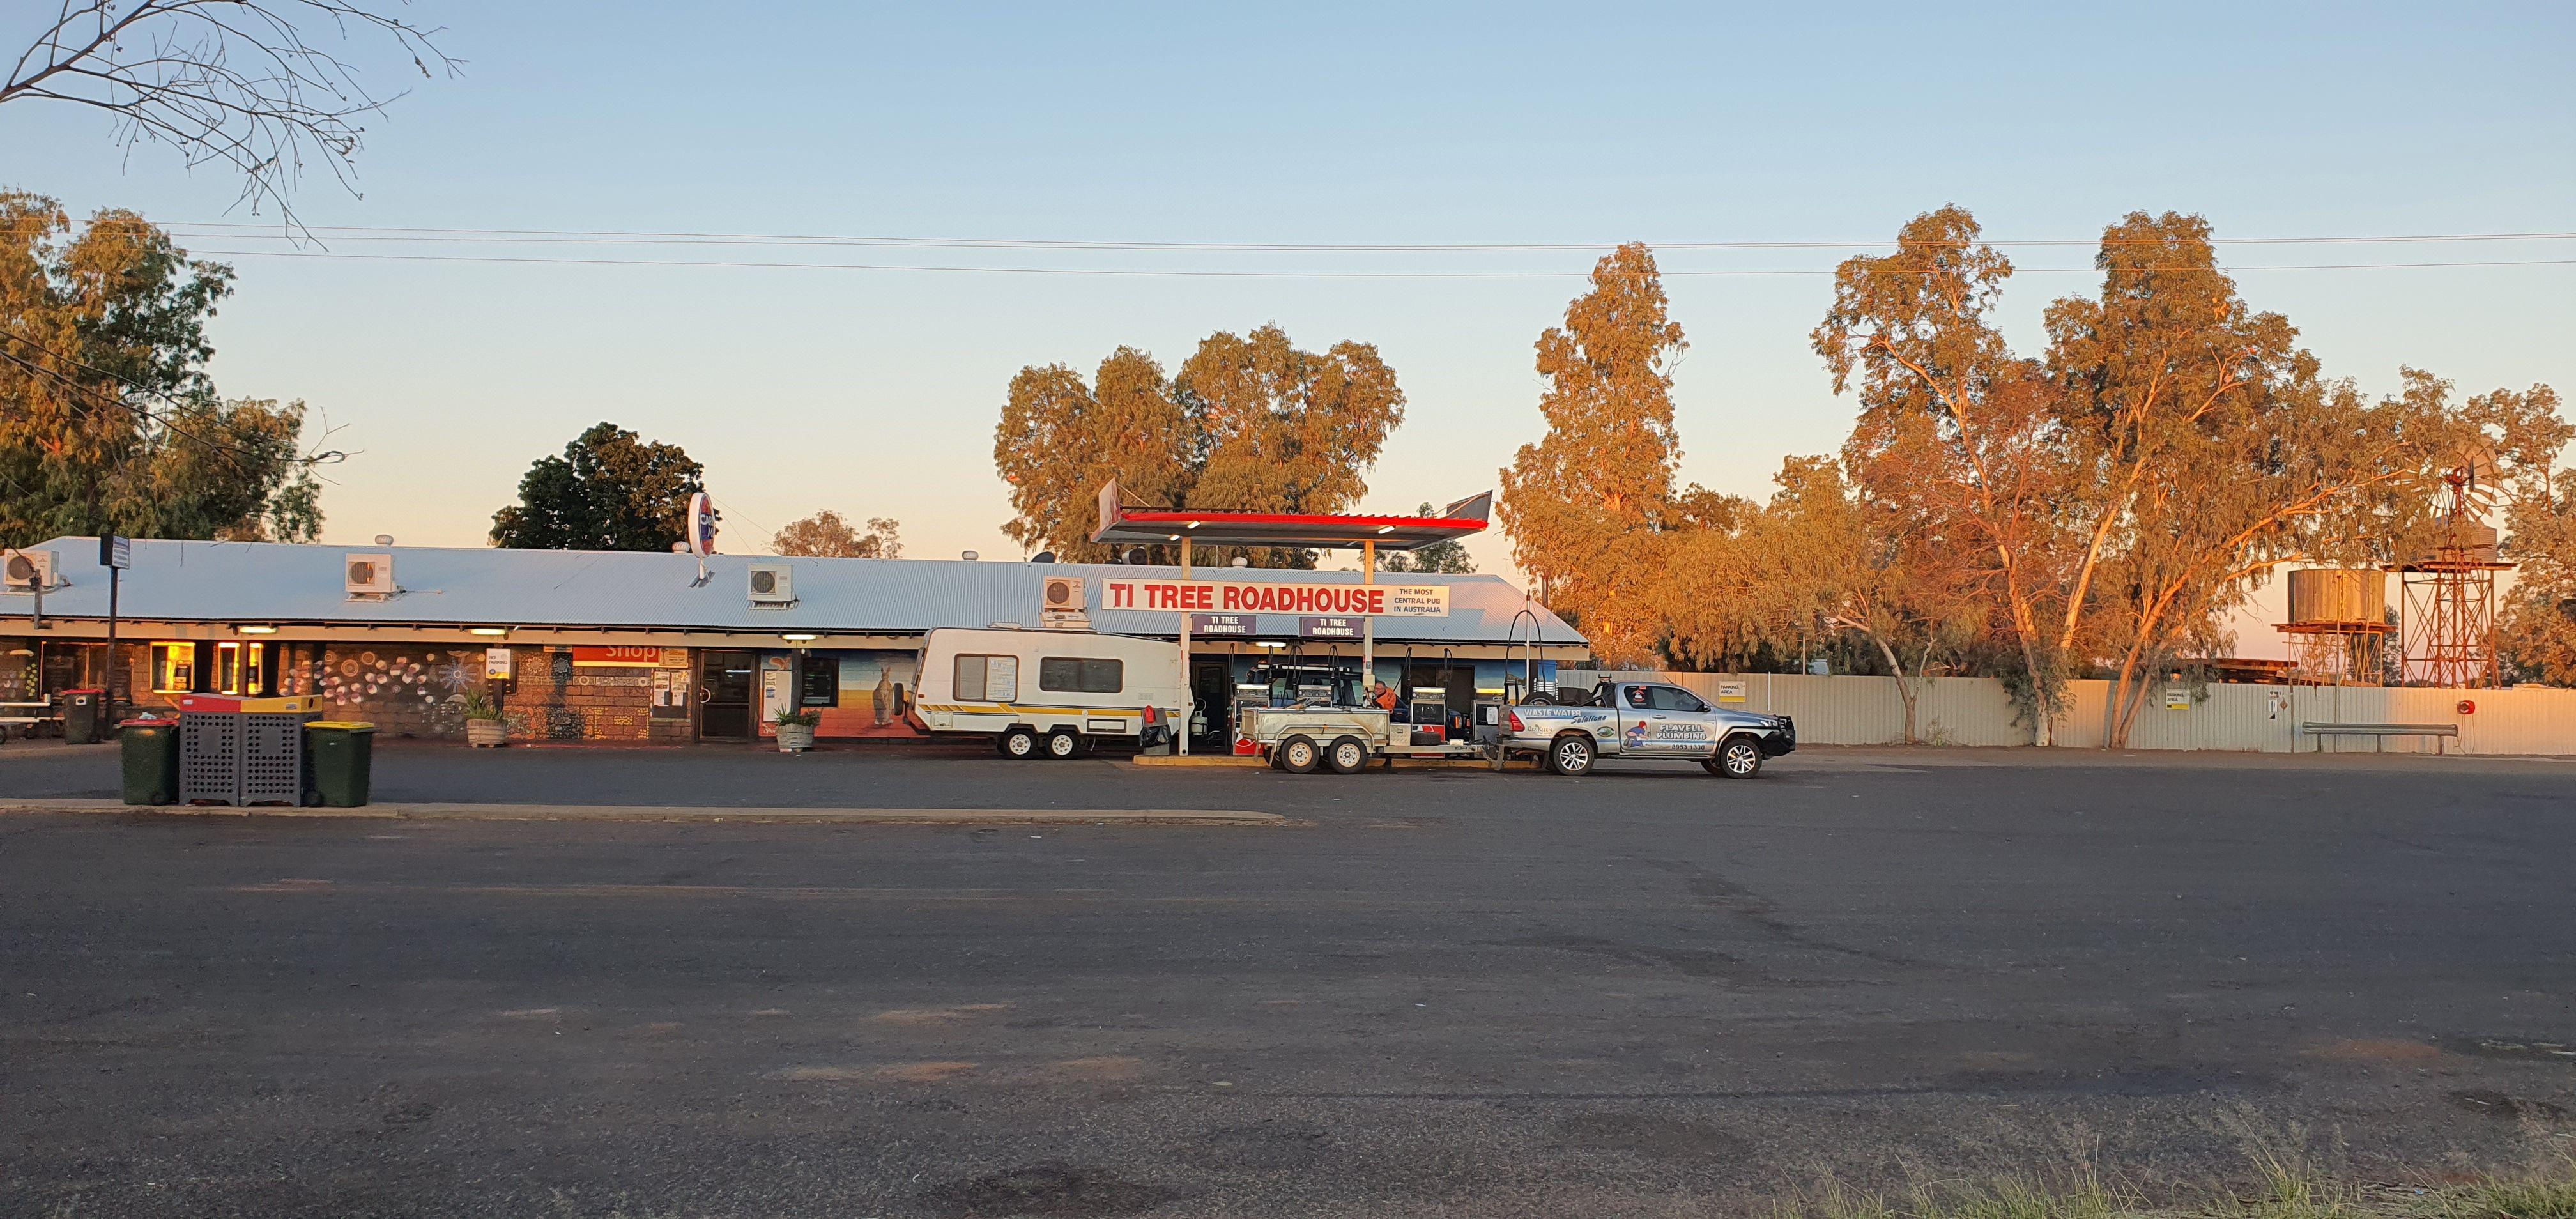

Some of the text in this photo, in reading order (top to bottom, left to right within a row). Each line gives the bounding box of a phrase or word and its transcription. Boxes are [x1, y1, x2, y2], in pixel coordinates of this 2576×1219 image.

[1110, 583, 1384, 613] TI TREE ROADHOUSE
[1221, 616, 1239, 624] TREE
[1319, 618, 1347, 627] TI TREE
[1204, 625, 1246, 634] ROADHOUSE
[1312, 627, 1354, 636] ROADHOUSE
[1657, 732, 1707, 740] PLUMBING
